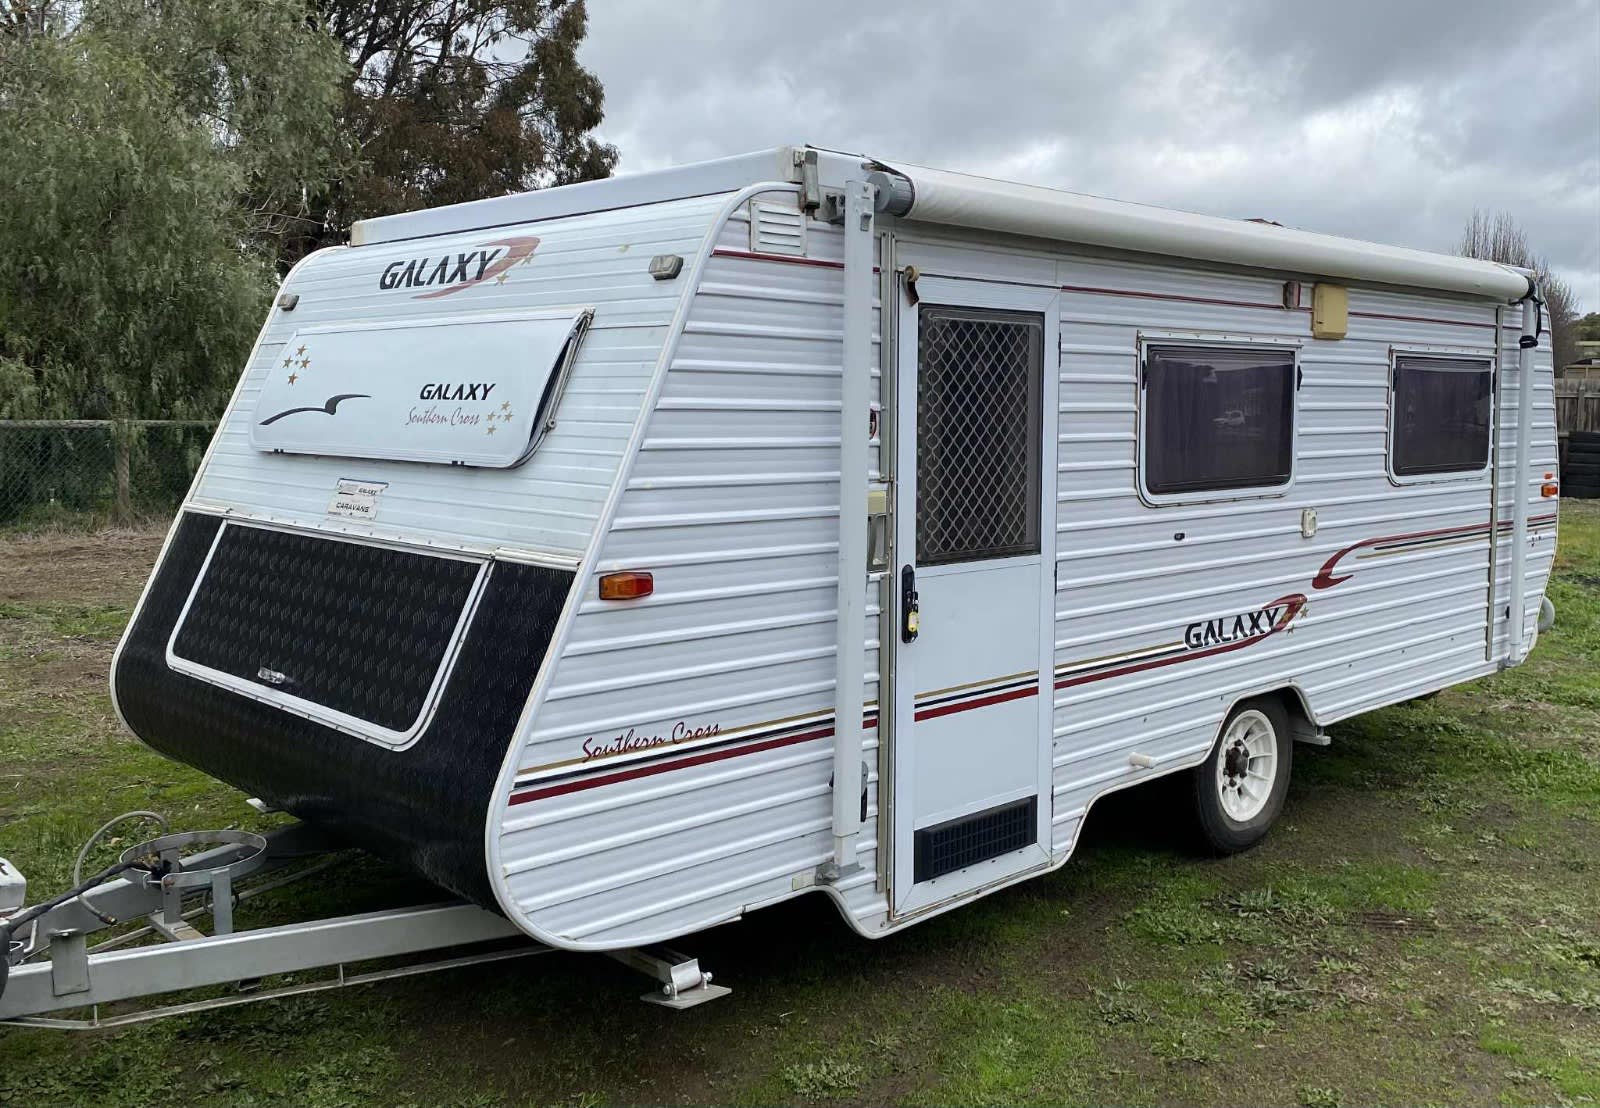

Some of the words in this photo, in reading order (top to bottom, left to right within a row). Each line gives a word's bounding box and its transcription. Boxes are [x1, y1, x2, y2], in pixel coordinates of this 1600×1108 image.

[380, 248, 502, 289] GALAXY
[420, 383, 496, 400] GALAXY
[405, 405, 448, 425] Southern
[451, 407, 481, 426] Cross
[1184, 607, 1280, 648] GALAXY
[582, 728, 666, 763] Southern
[672, 721, 722, 744] Cross
